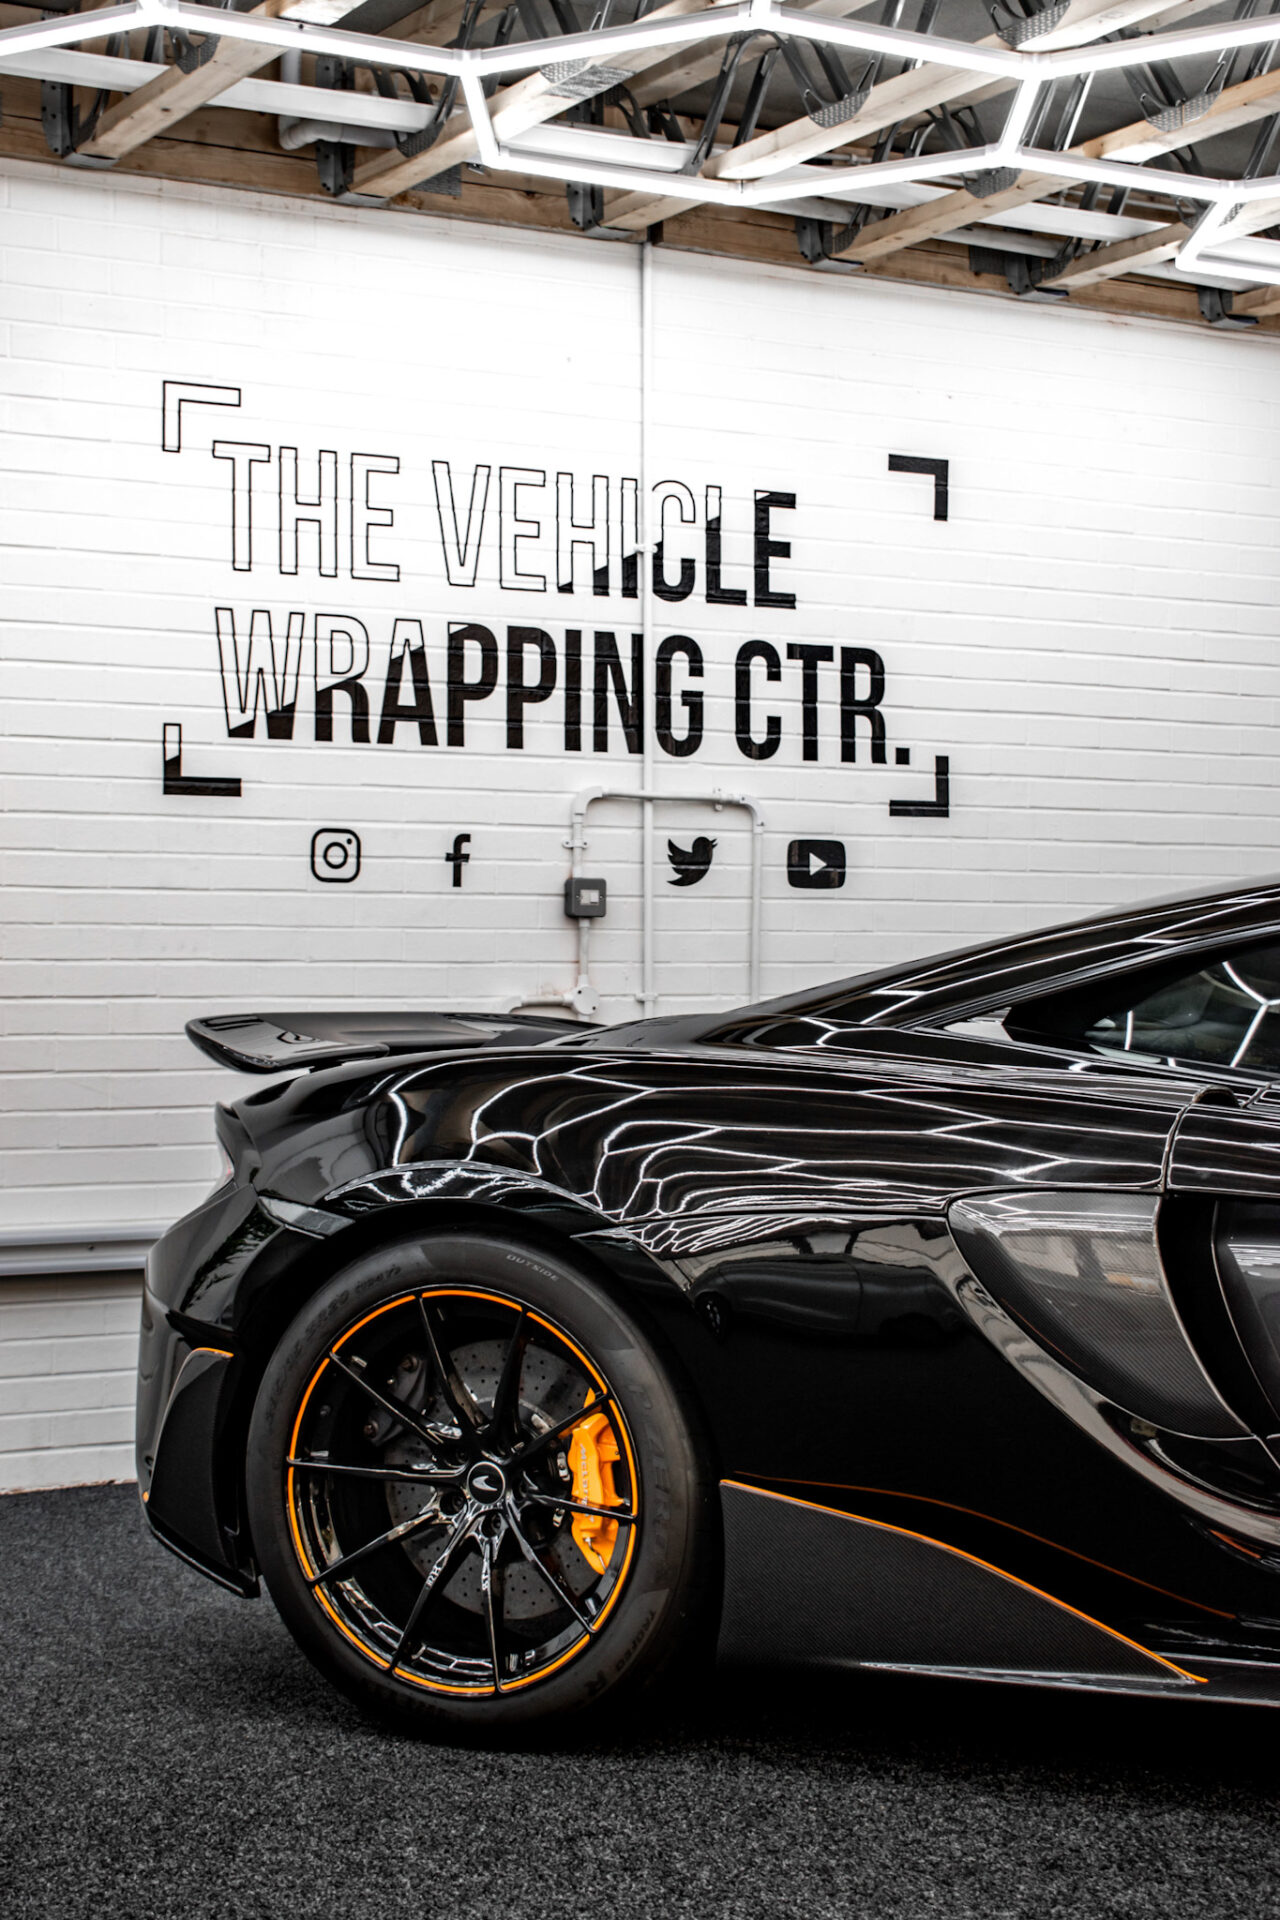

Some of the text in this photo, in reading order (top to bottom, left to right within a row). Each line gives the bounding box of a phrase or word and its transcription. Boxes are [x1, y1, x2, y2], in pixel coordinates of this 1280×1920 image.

[212, 440, 797, 609] THE VEHICLE
[215, 607, 910, 765] WRAPPING CTR.
[506, 1254, 559, 1281] OUTSIDE
